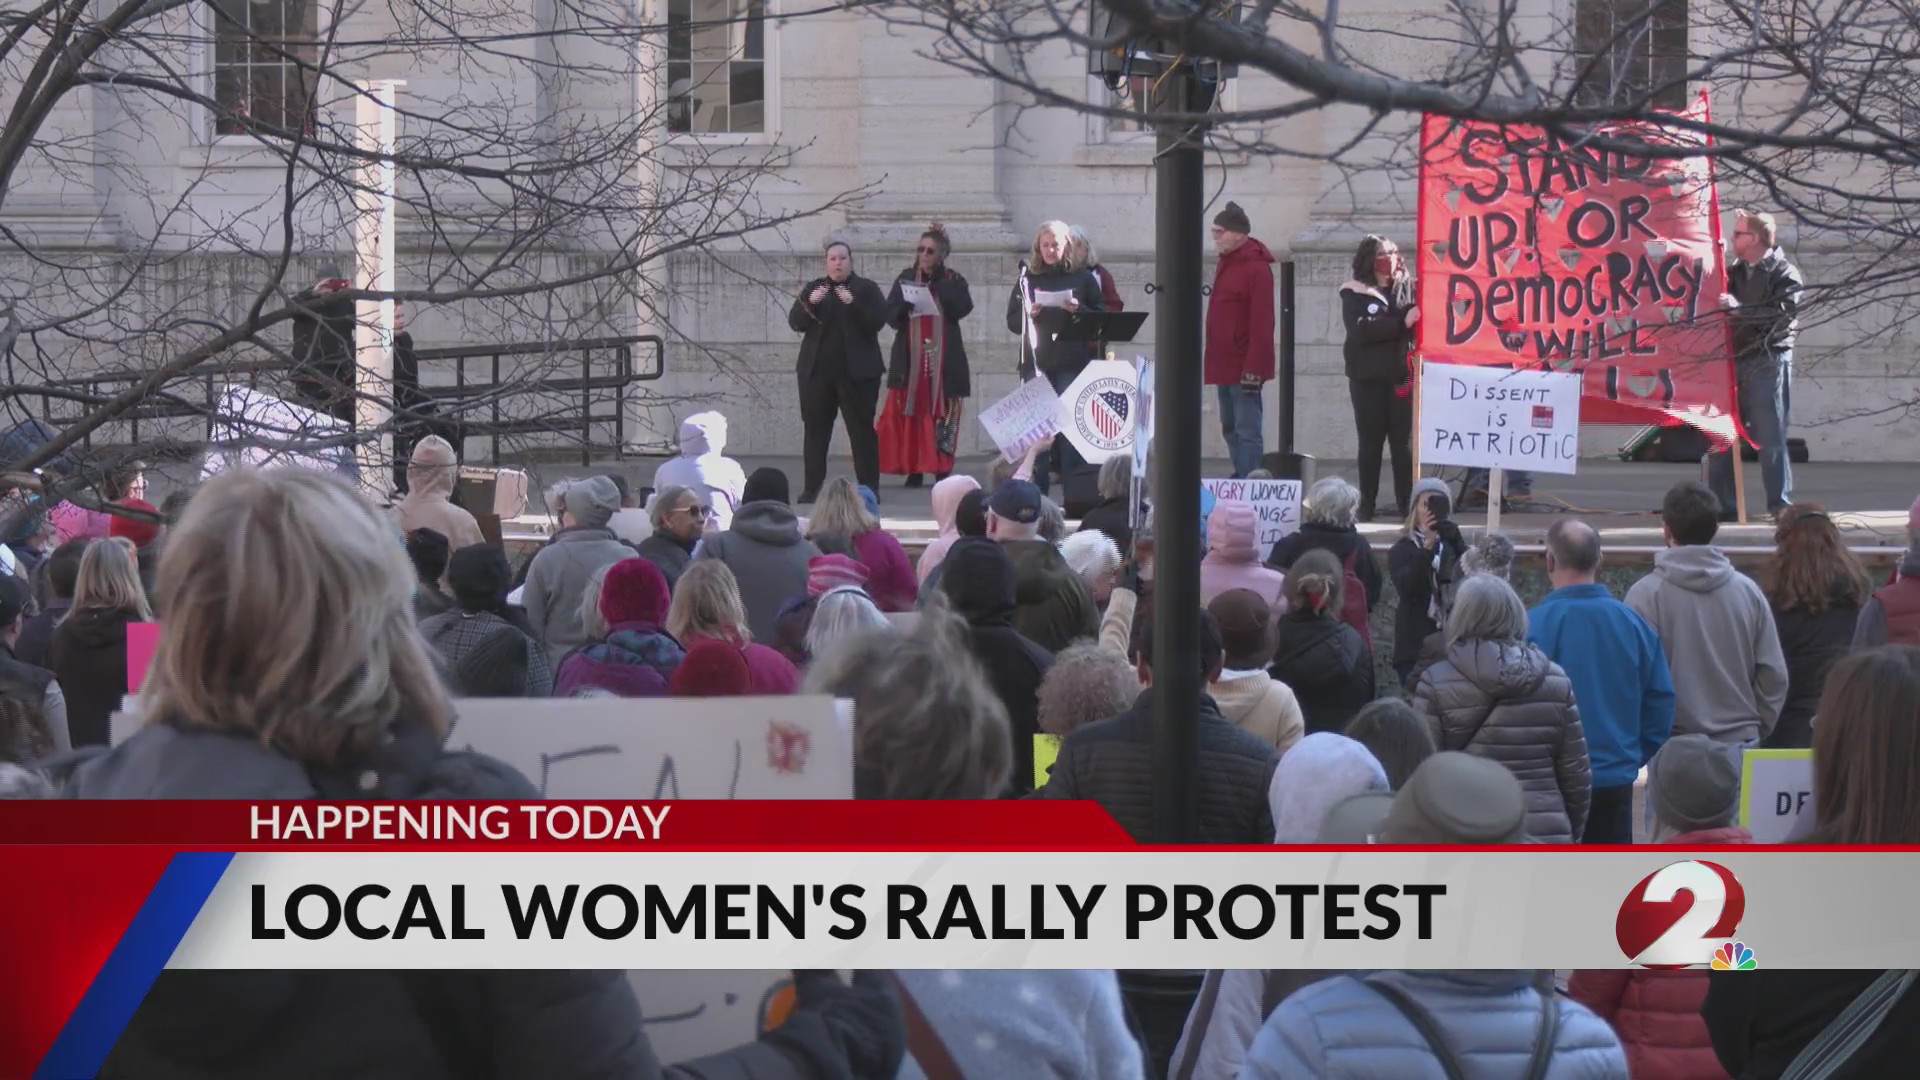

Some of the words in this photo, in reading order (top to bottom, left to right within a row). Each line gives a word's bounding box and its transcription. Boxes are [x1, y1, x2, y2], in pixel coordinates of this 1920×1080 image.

[1449, 206, 1537, 277] UP!
[1567, 195, 1659, 248] OR
[1251, 482, 1297, 501] WOMEN
